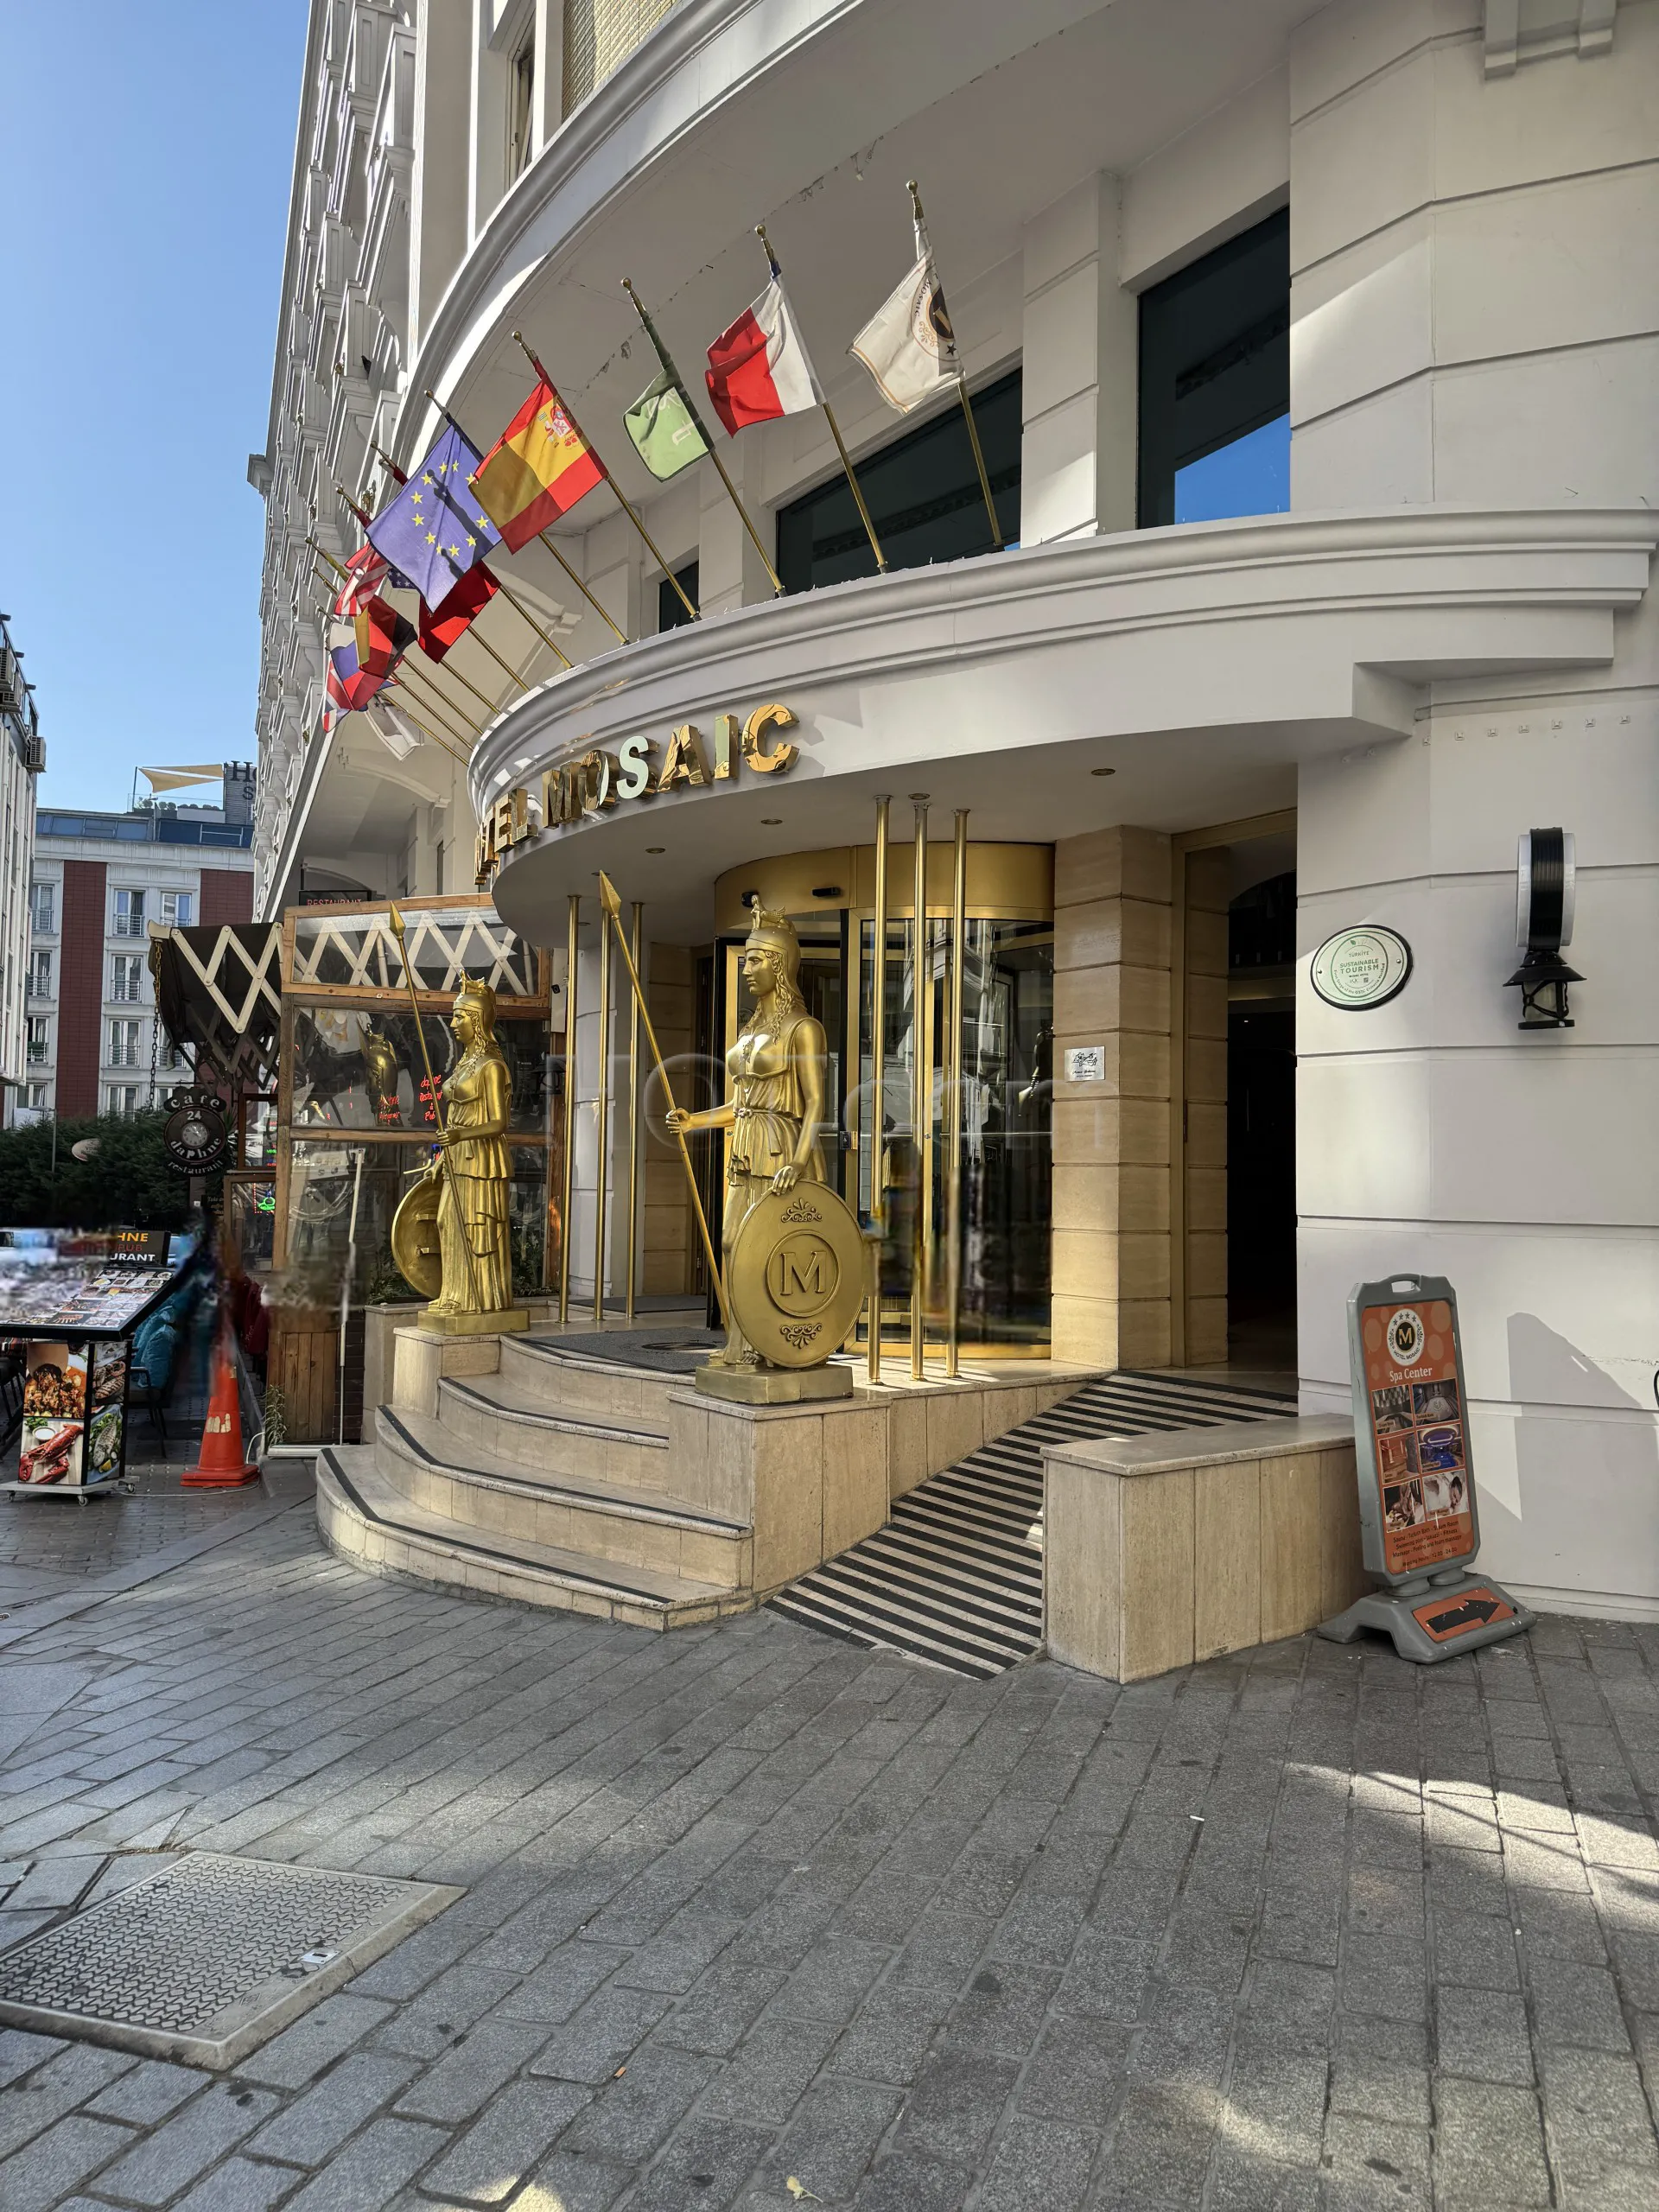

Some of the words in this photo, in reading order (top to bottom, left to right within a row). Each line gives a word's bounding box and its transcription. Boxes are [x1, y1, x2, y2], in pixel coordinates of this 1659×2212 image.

[542, 703, 800, 830] MOSAIC
[1339, 958, 1379, 969] SUSTAINABLE
[1340, 963, 1379, 975] TOURISM
[170, 1094, 220, 1109] cafe
[187, 1110, 202, 1121] 24
[170, 1138, 222, 1159] daphne
[780, 1250, 827, 1296] M
[1398, 1327, 1413, 1345] M
[1394, 1350, 1406, 1360] HOTEL
[1389, 1370, 1403, 1384] Spa
[1404, 1367, 1433, 1380] Center
